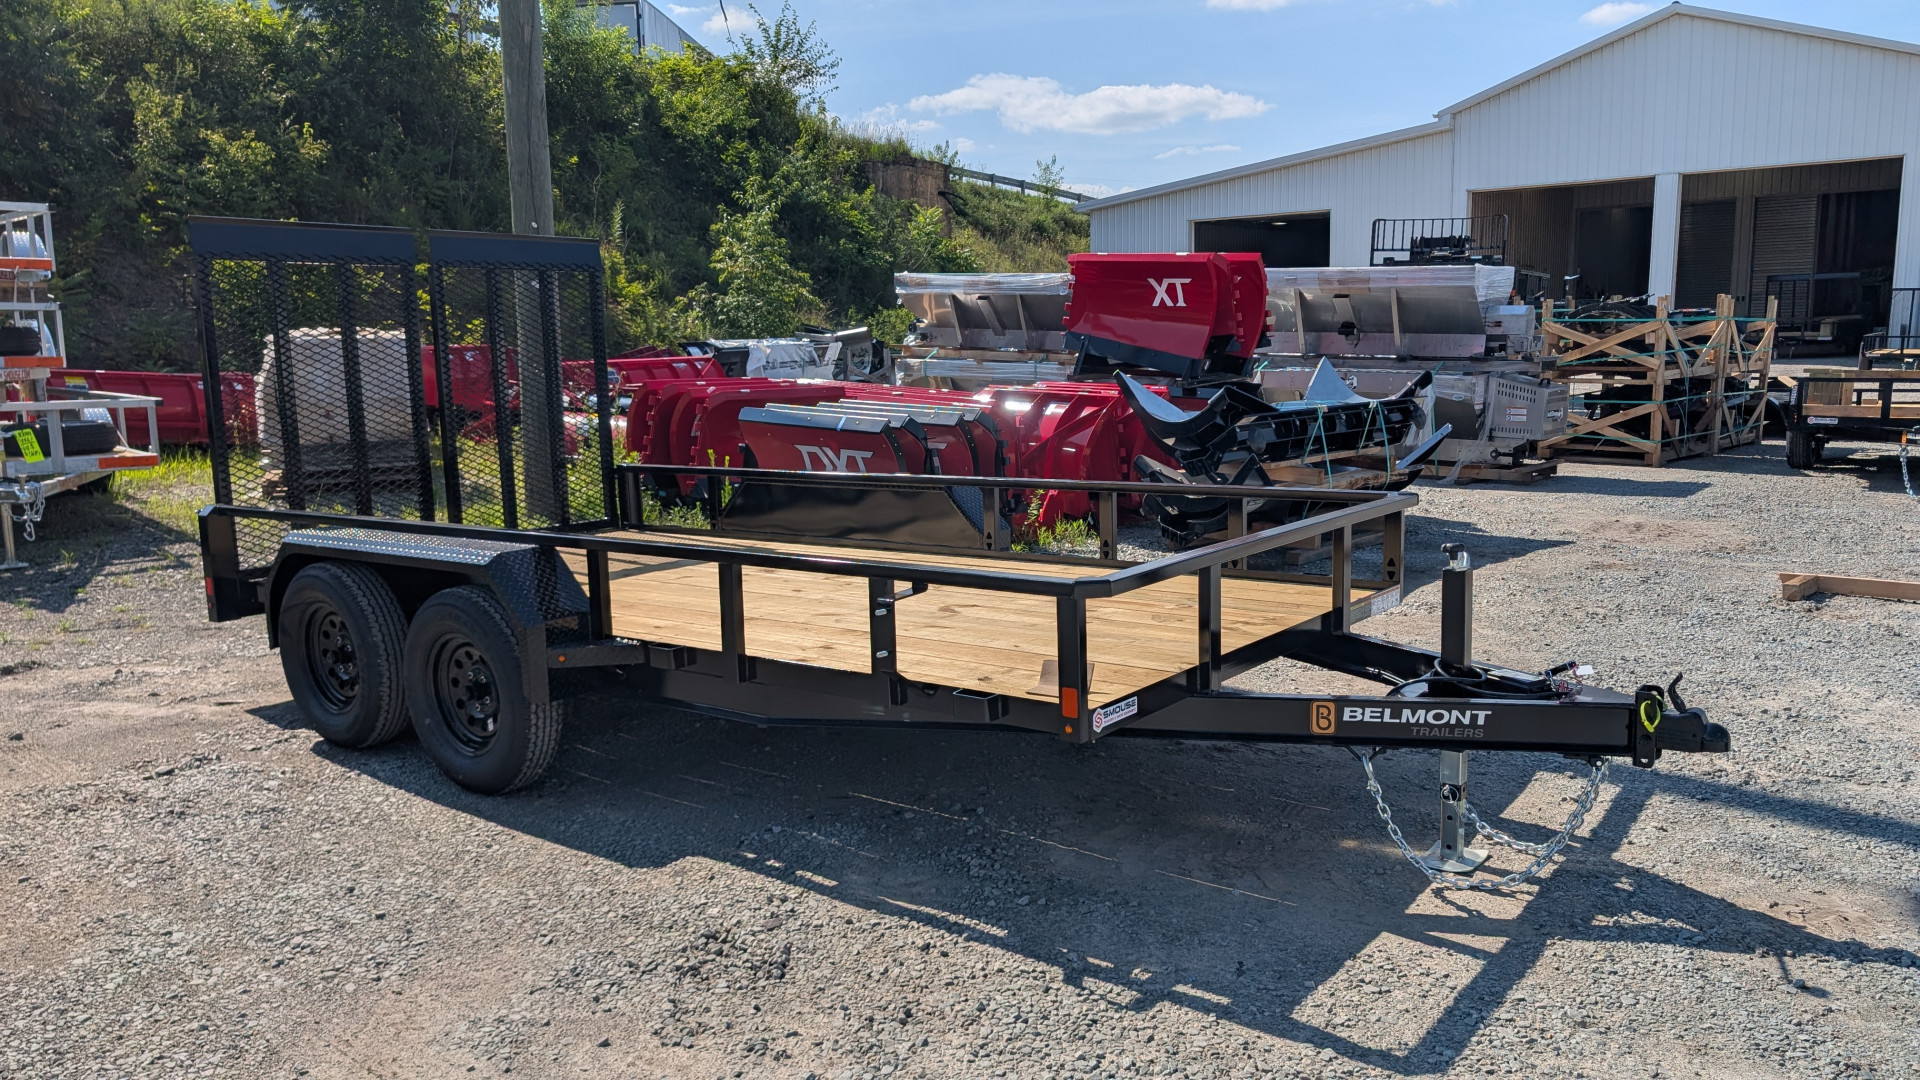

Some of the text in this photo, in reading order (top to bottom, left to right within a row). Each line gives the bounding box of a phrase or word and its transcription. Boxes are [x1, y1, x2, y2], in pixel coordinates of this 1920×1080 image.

[1146, 277, 1192, 307] XT
[1103, 699, 1136, 719] SMOUSE
[1343, 706, 1492, 726] BELMONT
[1411, 726, 1484, 738] TRAILERS
